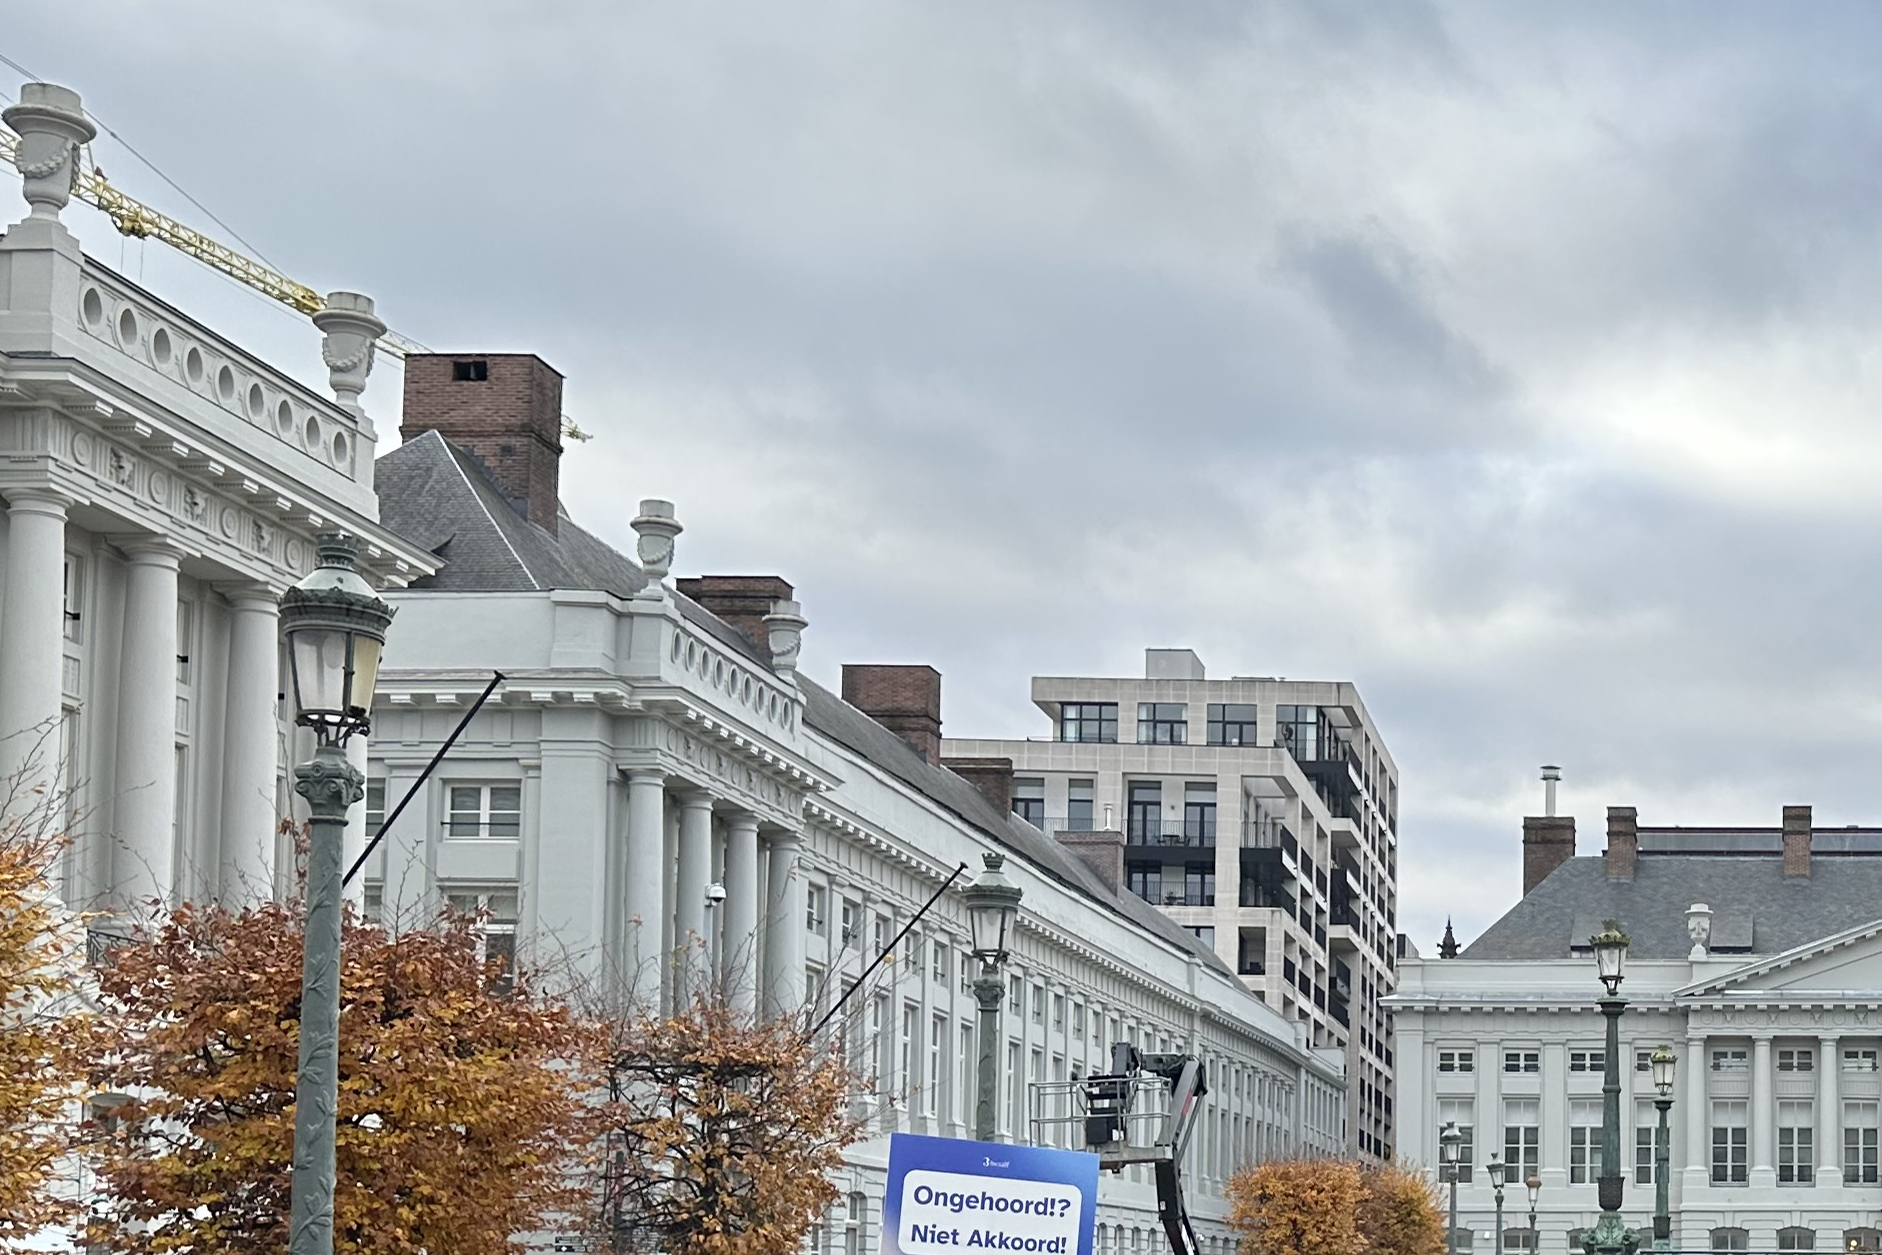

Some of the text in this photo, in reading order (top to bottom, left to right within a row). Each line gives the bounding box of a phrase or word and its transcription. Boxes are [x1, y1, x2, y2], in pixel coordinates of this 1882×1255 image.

[914, 1186, 1071, 1218] Ongehoord!?
[911, 1224, 1067, 1254] Niet Akkoord!
